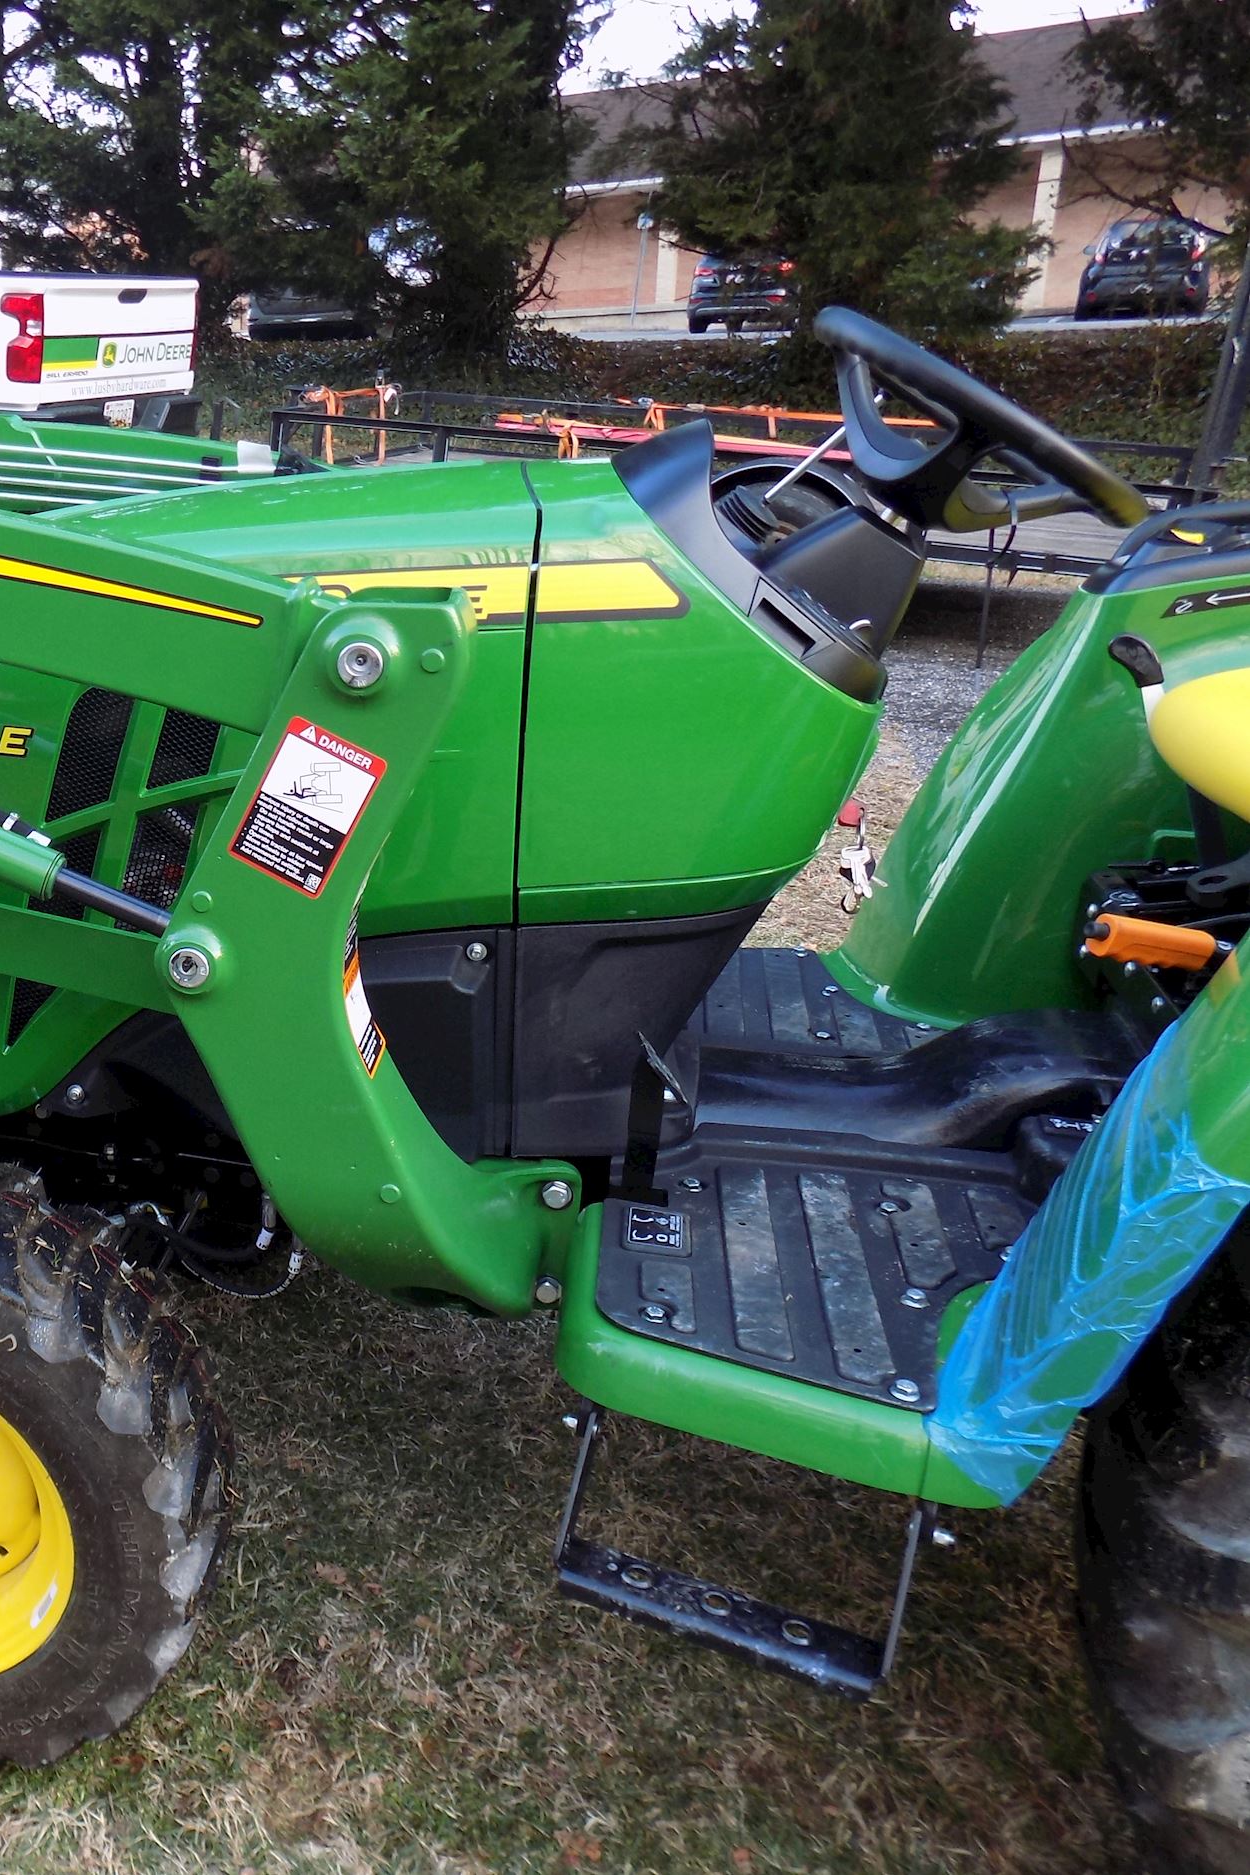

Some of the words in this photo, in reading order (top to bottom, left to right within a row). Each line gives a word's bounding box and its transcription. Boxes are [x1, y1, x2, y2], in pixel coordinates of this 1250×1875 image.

[119, 344, 155, 364] JOHN
[156, 342, 192, 361] DEERE
[317, 734, 373, 770] DANGER
